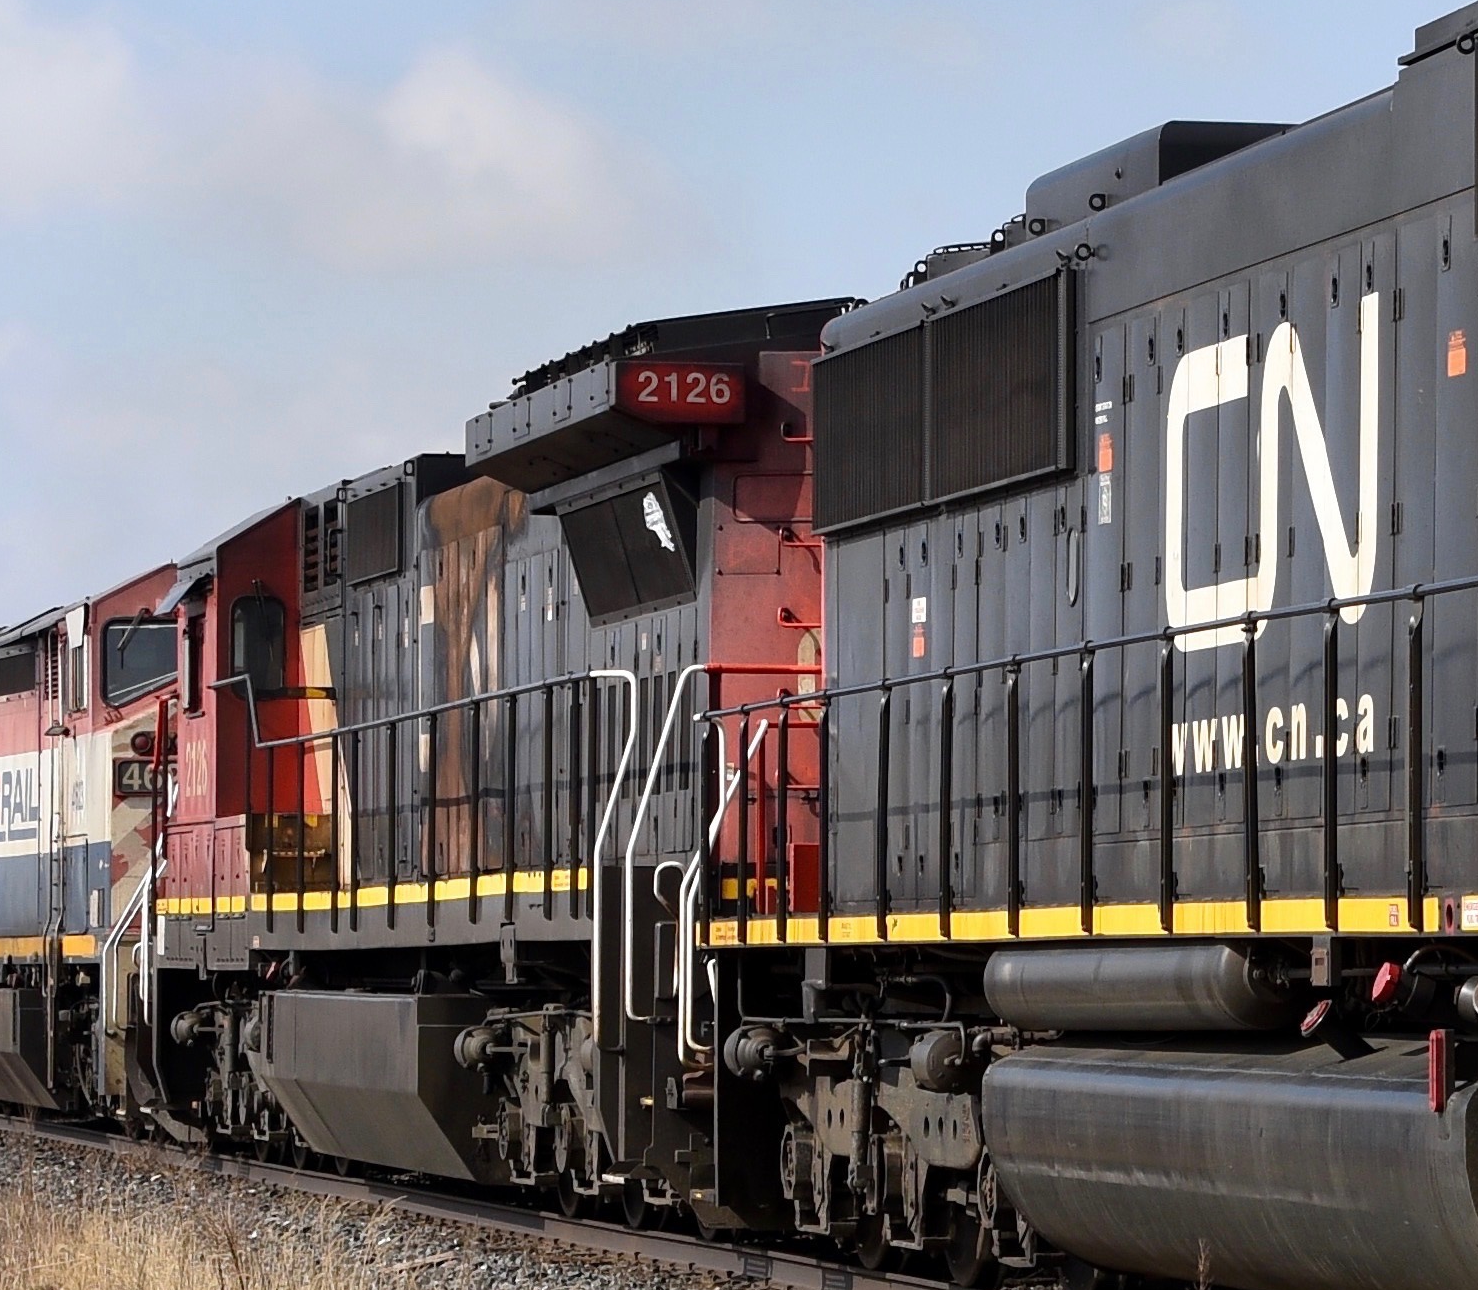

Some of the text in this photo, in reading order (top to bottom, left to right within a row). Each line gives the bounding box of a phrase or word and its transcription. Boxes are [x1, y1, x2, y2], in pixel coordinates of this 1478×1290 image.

[638, 370, 731, 405] 2126
[1165, 291, 1379, 653] CN
[185, 739, 209, 798] 2126
[1172, 693, 1375, 777] wwwcn.ca
